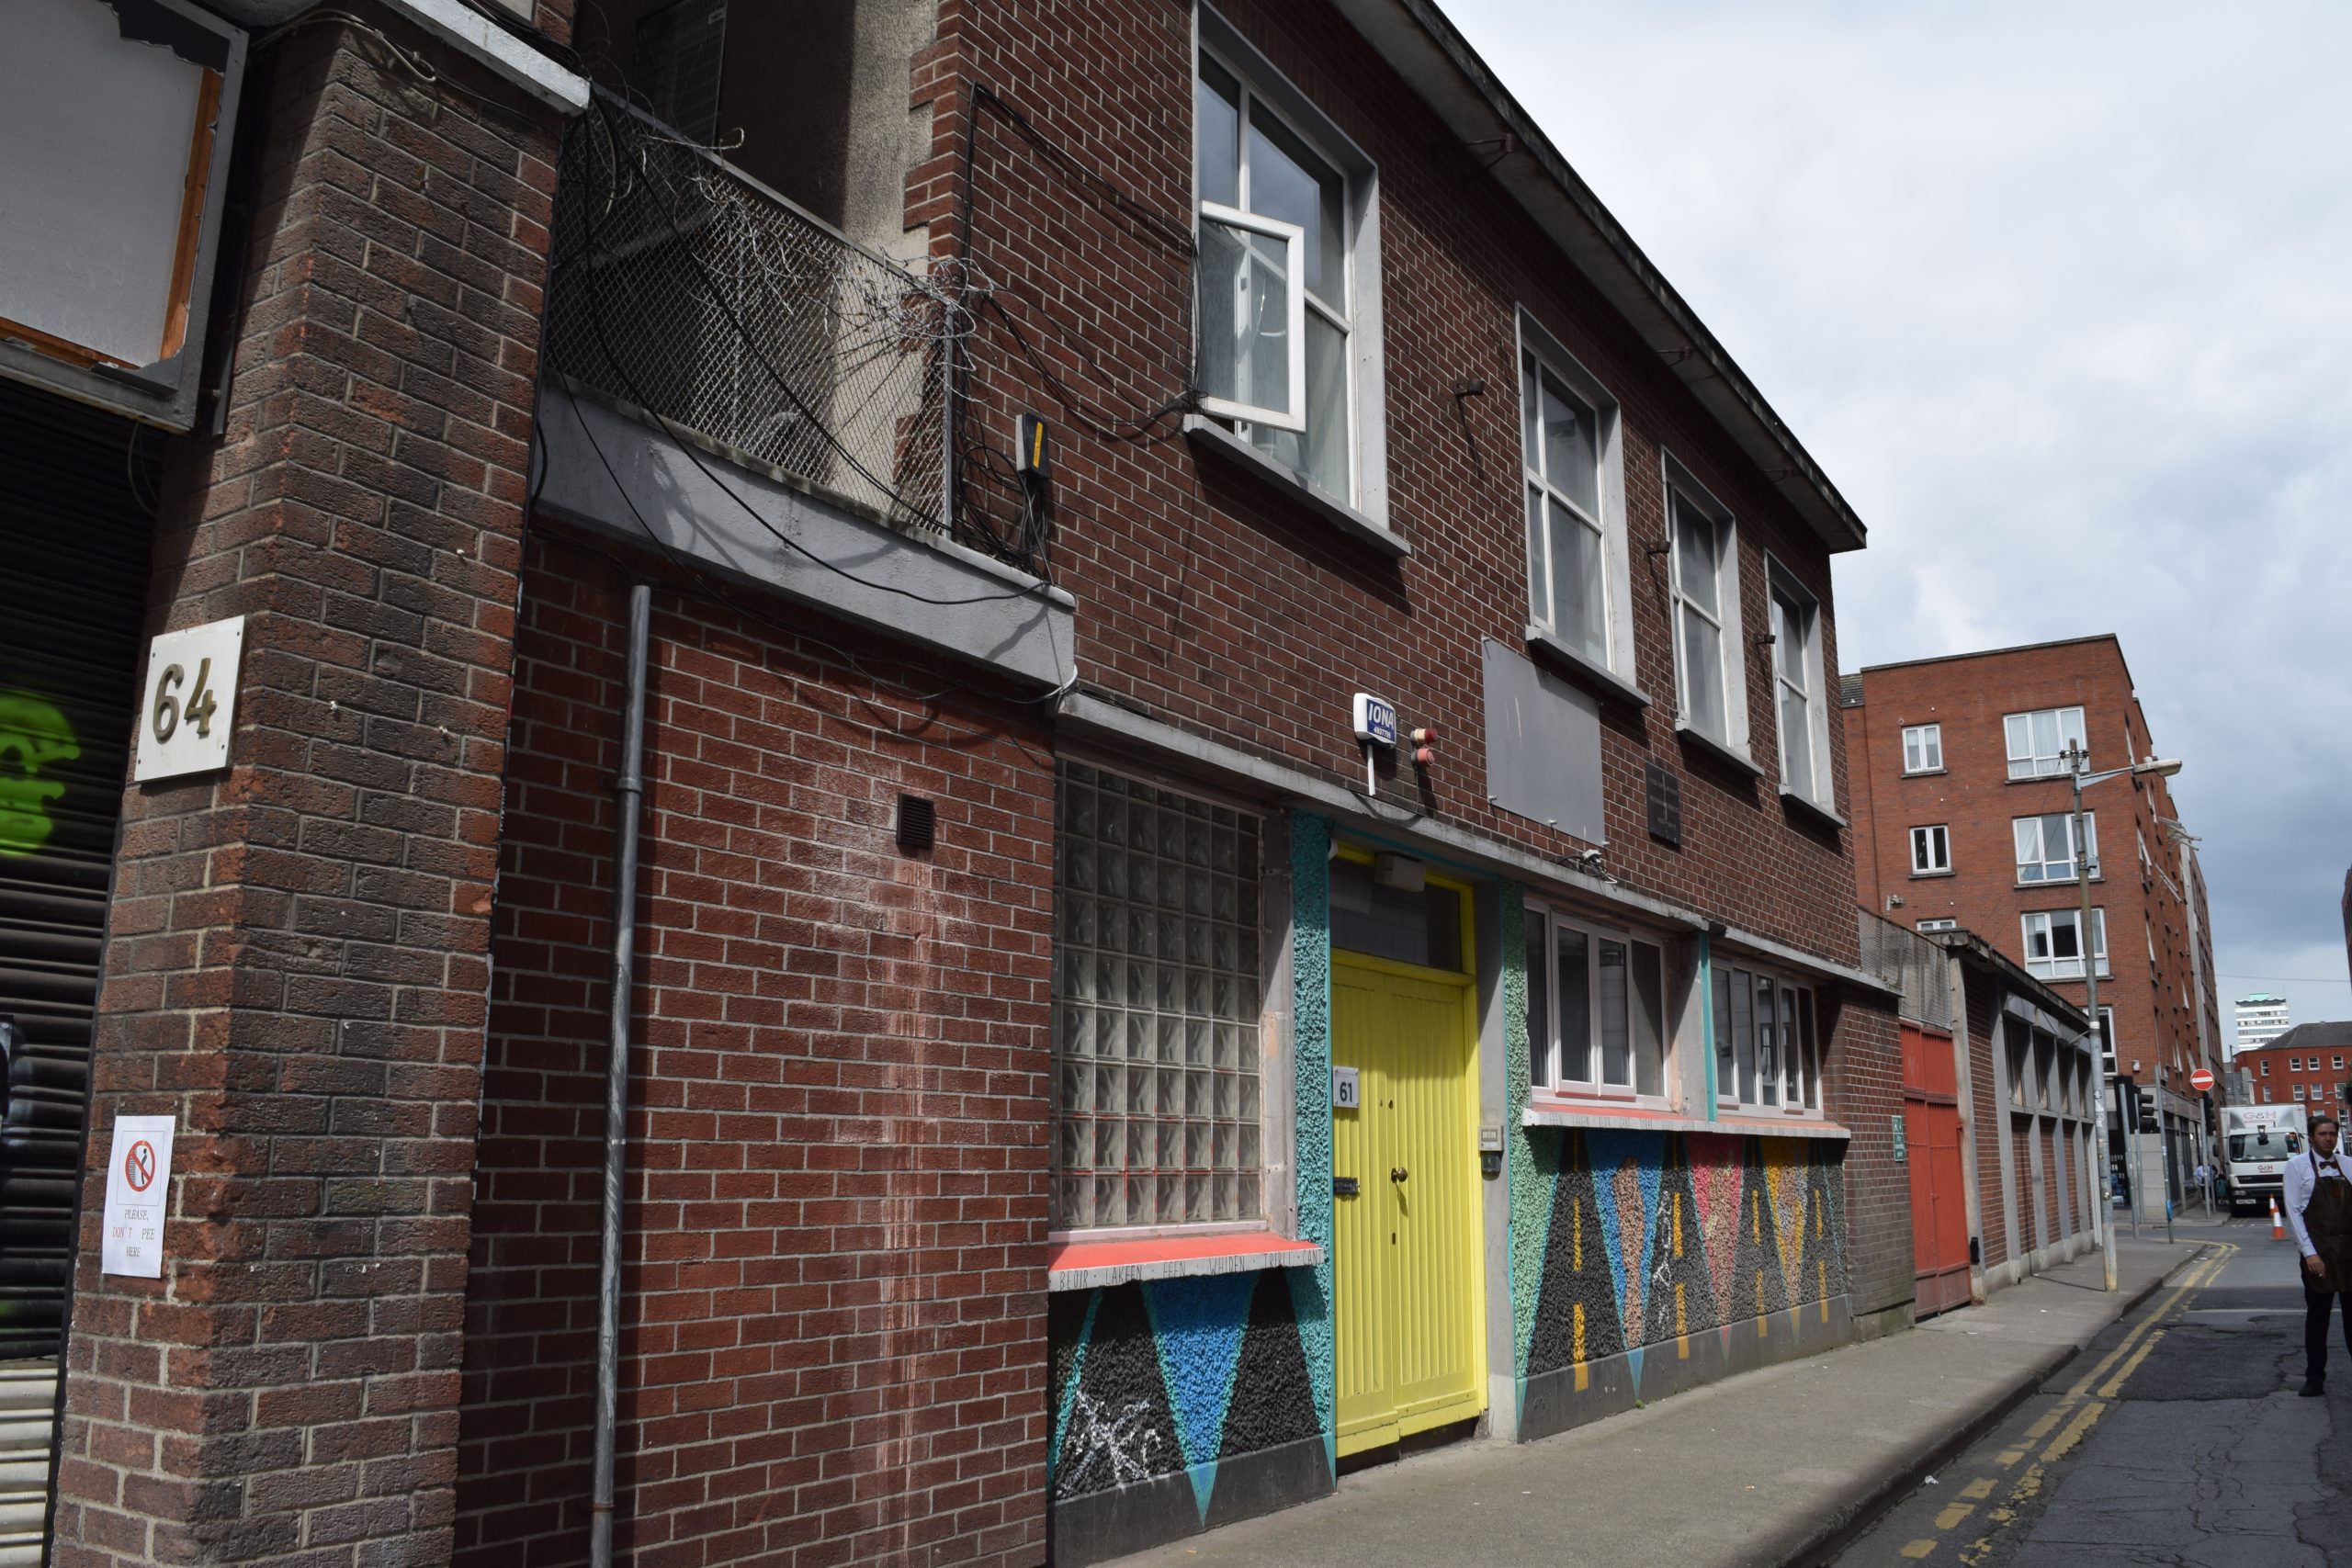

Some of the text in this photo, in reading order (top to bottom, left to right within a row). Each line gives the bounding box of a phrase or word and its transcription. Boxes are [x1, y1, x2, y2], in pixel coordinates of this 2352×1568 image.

[153, 657, 217, 744] 64
[1368, 703, 1395, 730] IONA
[1340, 1081, 1352, 1102] 61
[2244, 1111, 2277, 1120] G&H
[124, 1209, 149, 1222] PLEASE,
[112, 1226, 155, 1240] DON'T PEE
[126, 1246, 141, 1258] HERE
